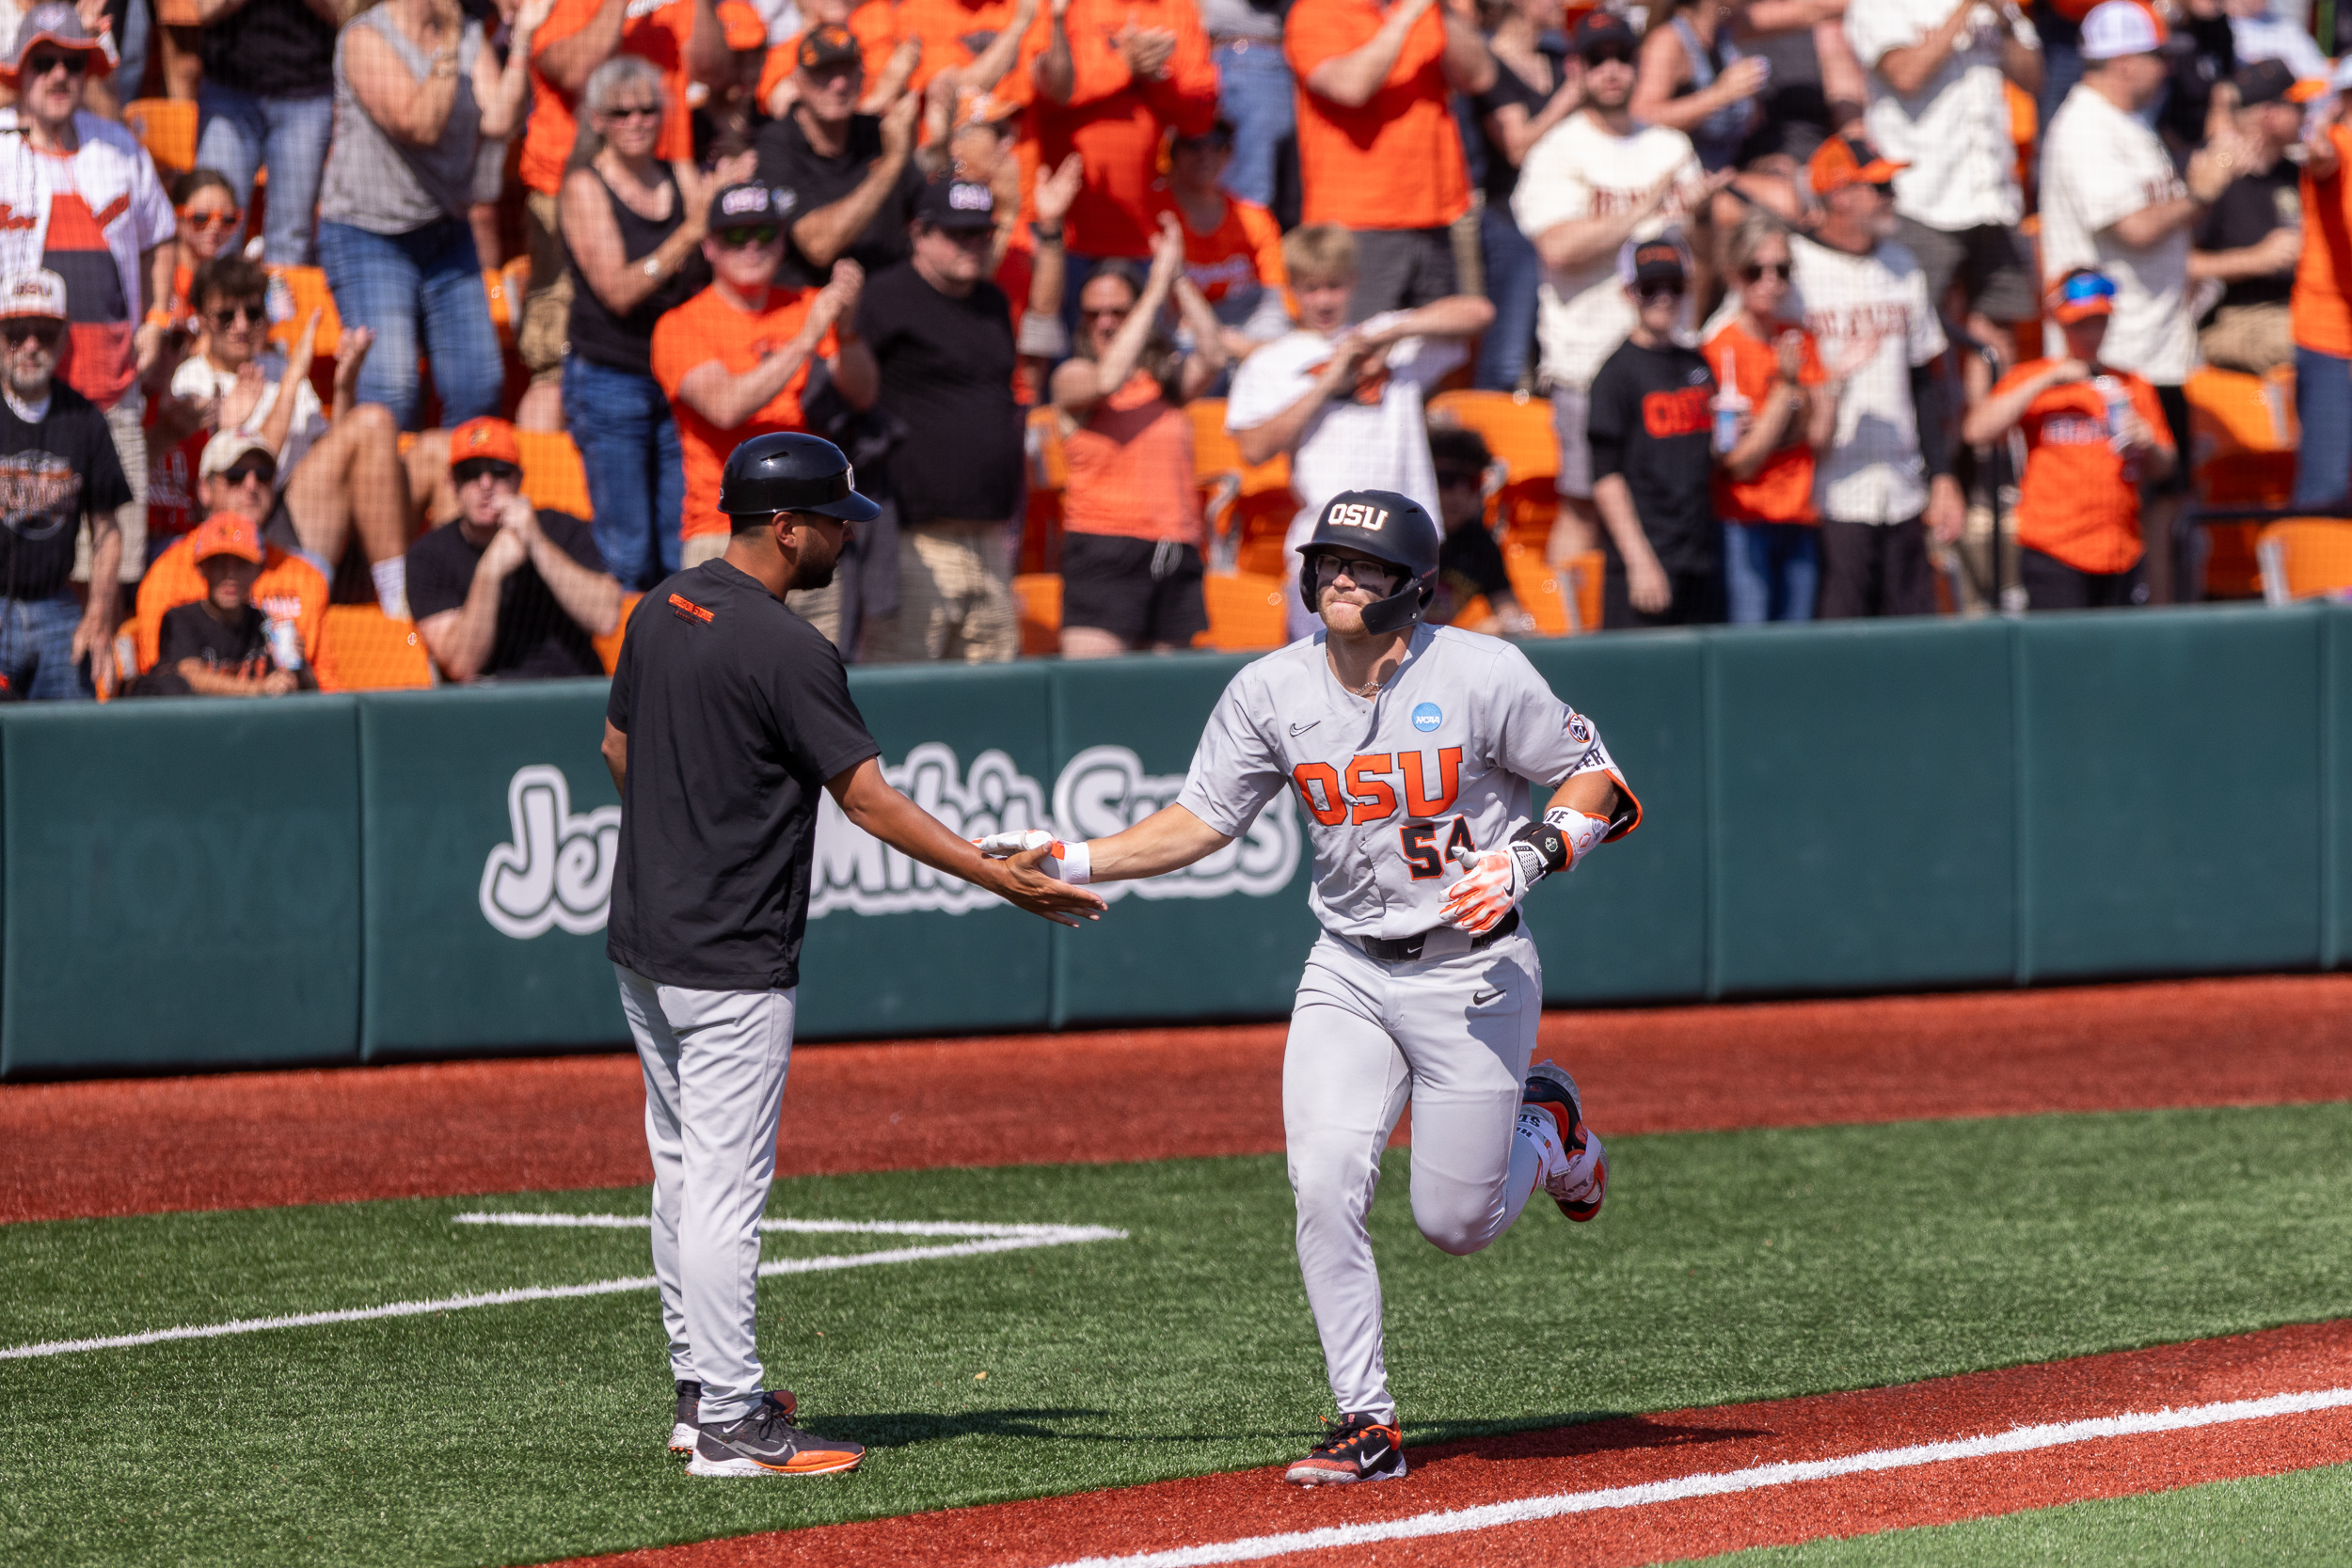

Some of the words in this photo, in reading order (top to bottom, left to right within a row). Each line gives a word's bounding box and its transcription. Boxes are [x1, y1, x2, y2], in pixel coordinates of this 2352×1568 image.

[1327, 503, 1389, 531] OSU
[668, 593, 695, 613] OREGON
[692, 605, 715, 623] STATE
[1415, 716, 1440, 724] NCAA
[1293, 746, 1463, 826] OSU
[1398, 815, 1476, 881] 54
